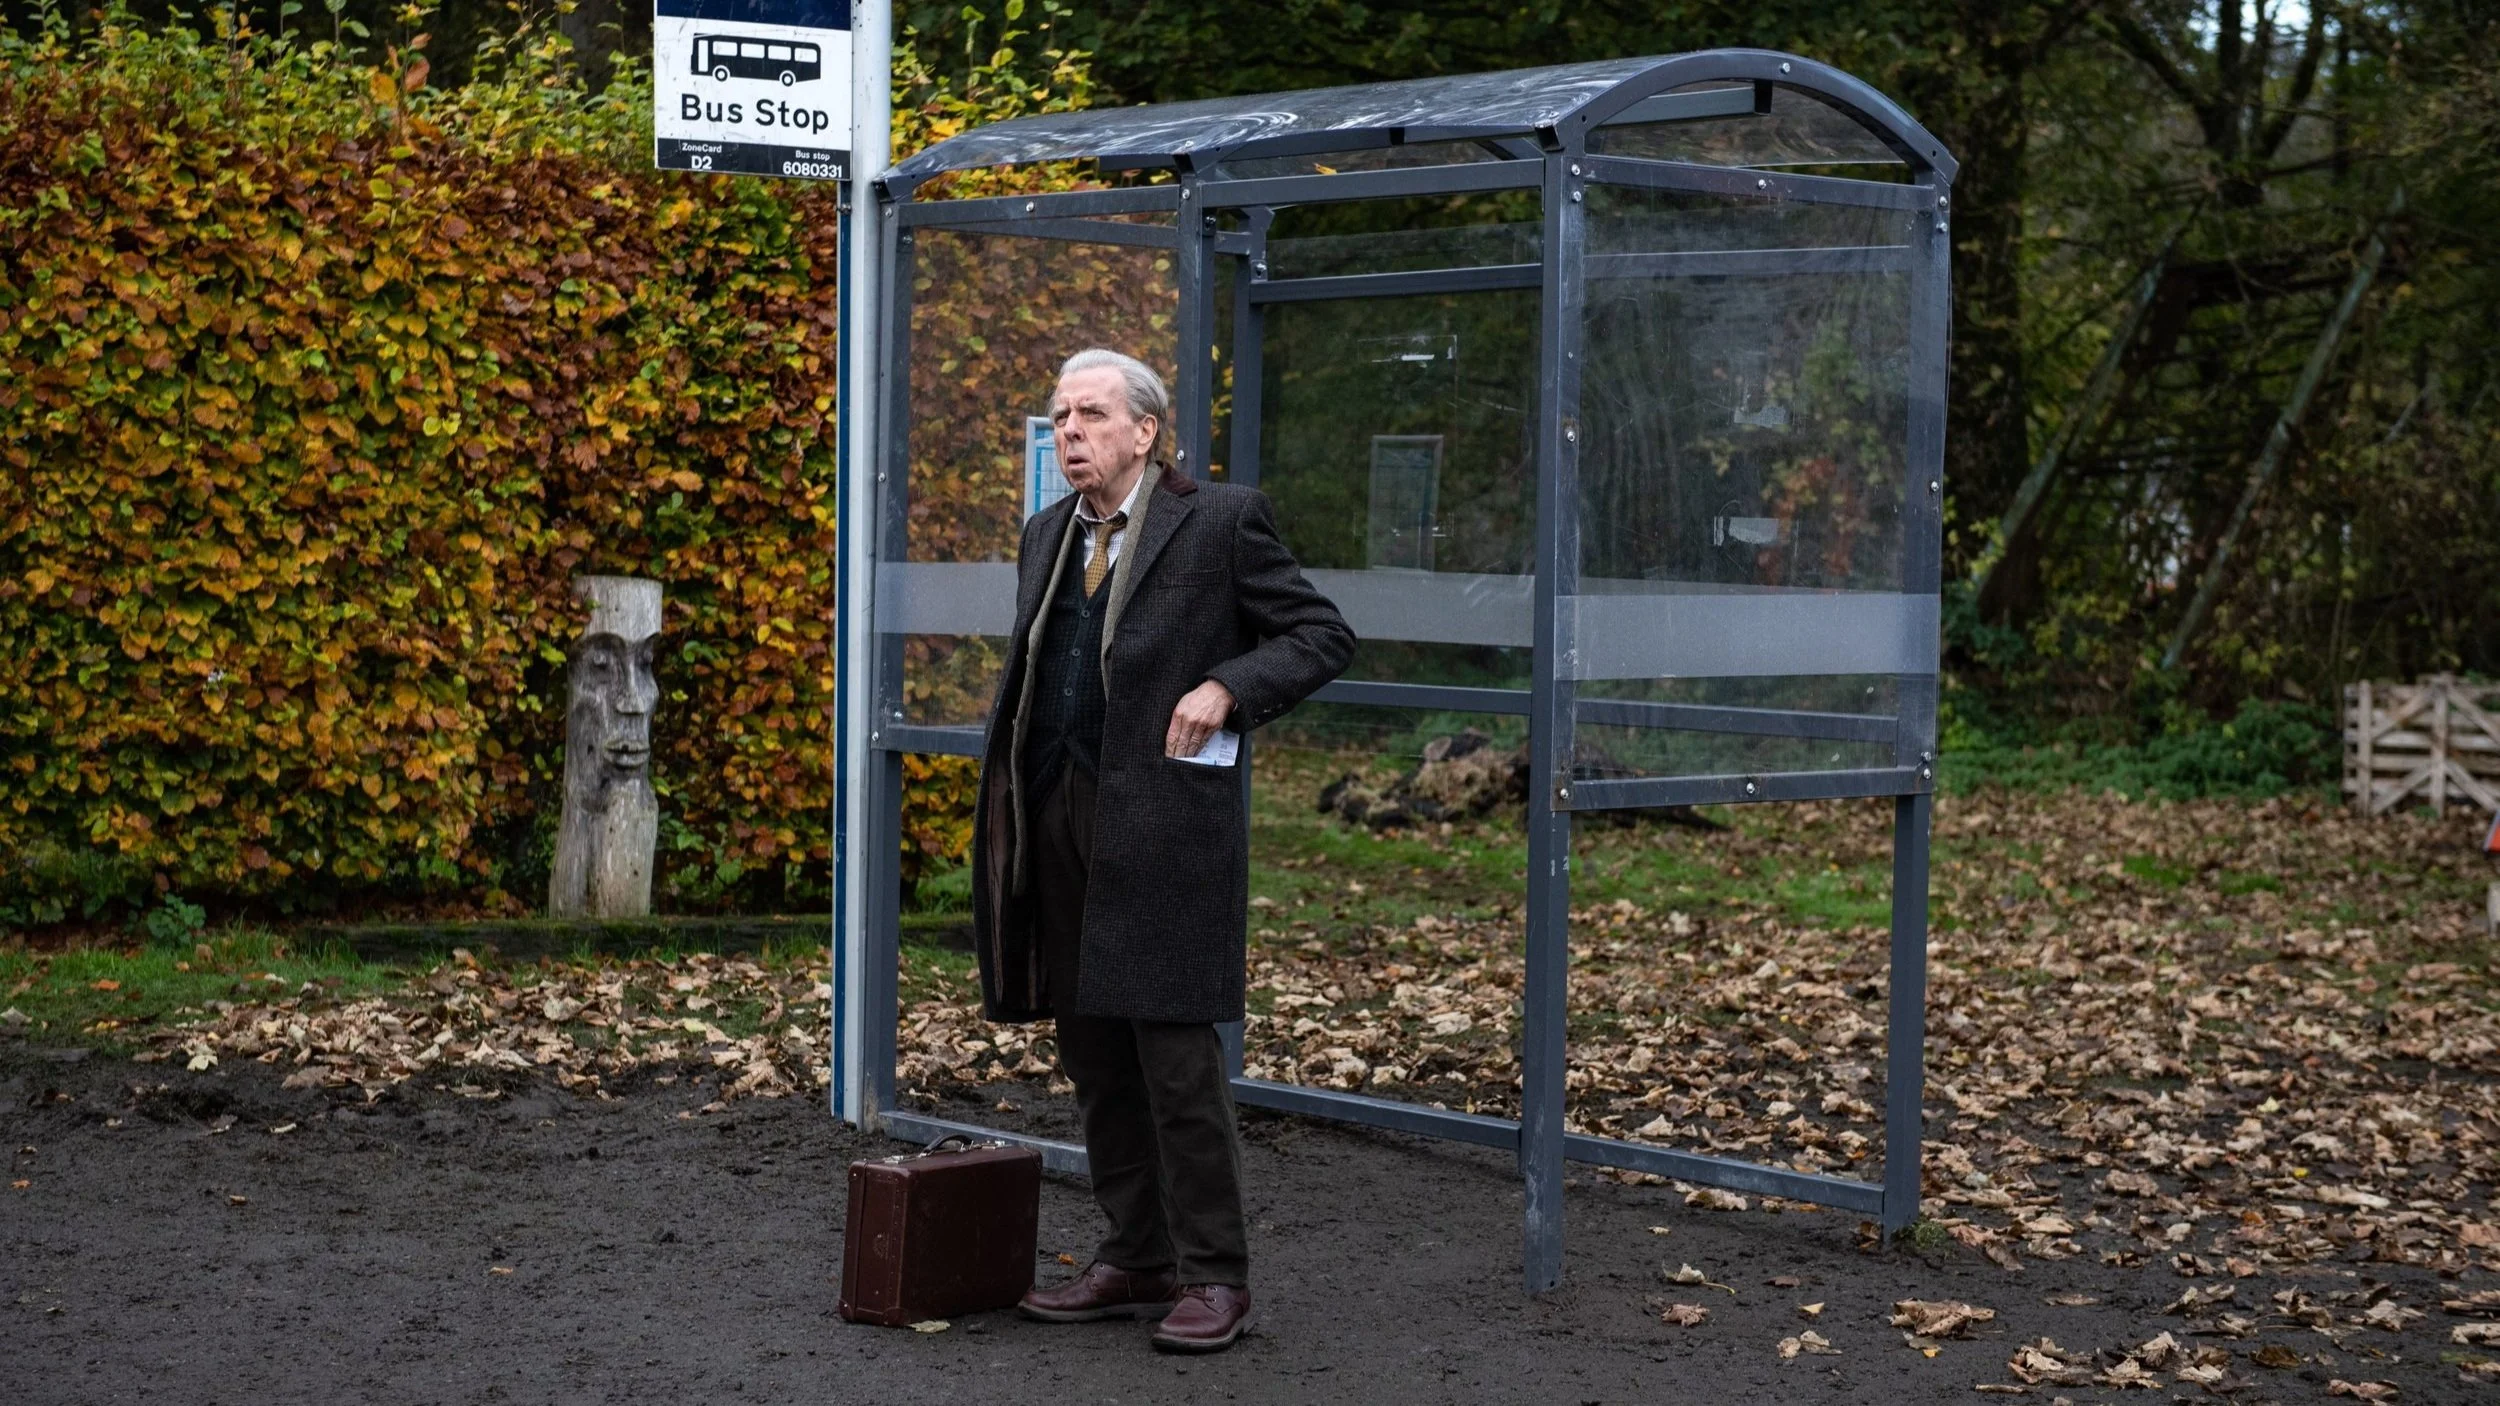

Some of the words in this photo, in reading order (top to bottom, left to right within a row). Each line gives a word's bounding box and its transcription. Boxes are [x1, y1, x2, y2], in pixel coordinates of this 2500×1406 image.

[681, 93, 743, 124] Bus
[755, 98, 829, 135] Stop
[681, 142, 722, 154] ZoneCard
[795, 149, 810, 159] Bus
[812, 151, 831, 162] stop
[691, 155, 713, 170] D2
[782, 161, 842, 178] 6080331
